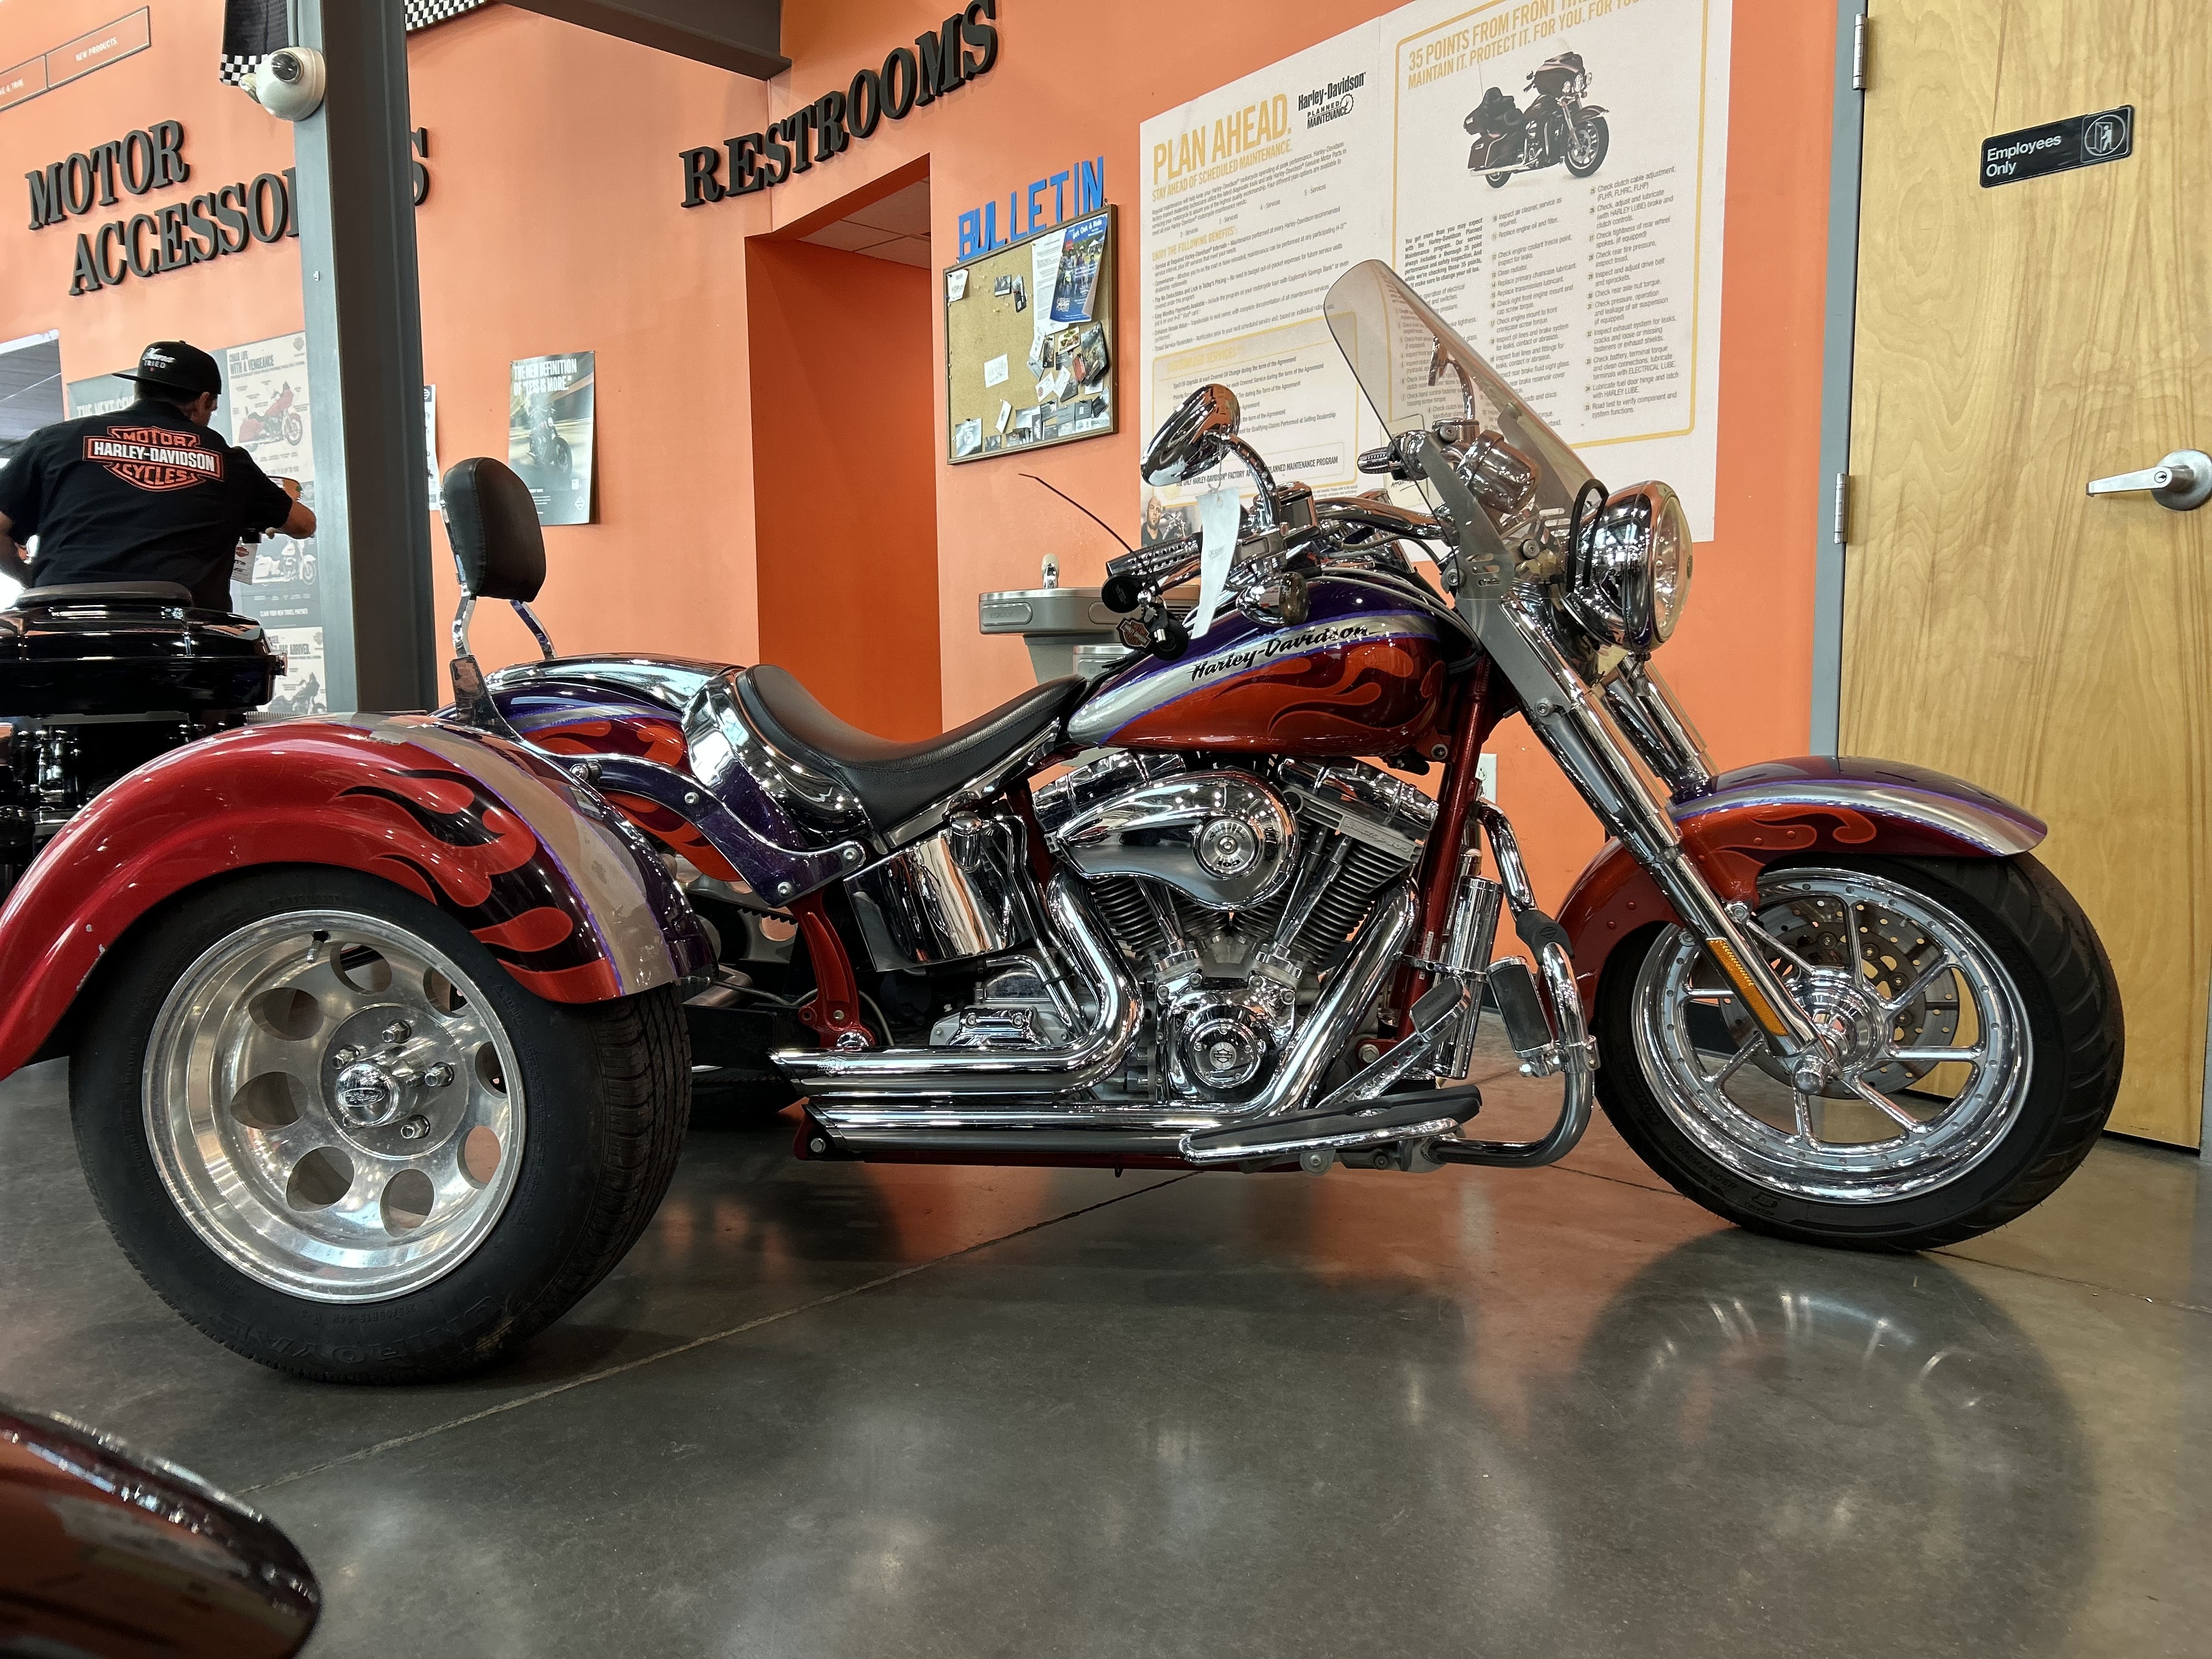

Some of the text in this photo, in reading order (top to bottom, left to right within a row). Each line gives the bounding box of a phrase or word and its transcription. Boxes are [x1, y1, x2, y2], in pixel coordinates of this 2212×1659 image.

[88, 37, 117, 55] PRODUCTS
[1408, 59, 1454, 89] MAINTAIN
[1456, 53, 1466, 71] IT.
[1470, 35, 1516, 65] PROTECT
[1519, 28, 1531, 46] IT.
[1533, 18, 1556, 41] FOR
[1559, 8, 1584, 30] YOU.
[1409, 48, 1423, 71] 35
[1426, 31, 1469, 68] POINTS
[1473, 12, 1509, 43] FROM
[679, 0, 998, 208] RESTROOMS
[1307, 100, 1340, 118] PLANNED
[1307, 106, 1350, 129] MAINTENANCE
[1153, 93, 1291, 186] PLAN AHEAD.
[1987, 136, 2062, 161] Employees
[25, 120, 190, 230] MOTOR
[1153, 139, 1292, 202] STAY AHEAD OF SCHEDULED MAINTENANCE.
[1985, 160, 2017, 177] Only
[958, 156, 1104, 263] BULLETIN
[144, 360, 166, 369] TRIED
[514, 364, 525, 381] THE
[539, 358, 577, 377] DEFINITION
[123, 430, 188, 447] MOTOR
[94, 441, 215, 472] HARLEY-DAVIDSON
[1286, 459, 1315, 471] MAINTENANCE
[1316, 456, 1338, 466] PROGRAM
[122, 463, 188, 486] CYCLES
[1228, 470, 1245, 479] FACTORY
[1191, 625, 1369, 682] Harley-Davidson
[1671, 1139, 1739, 1190] COMMANDER
